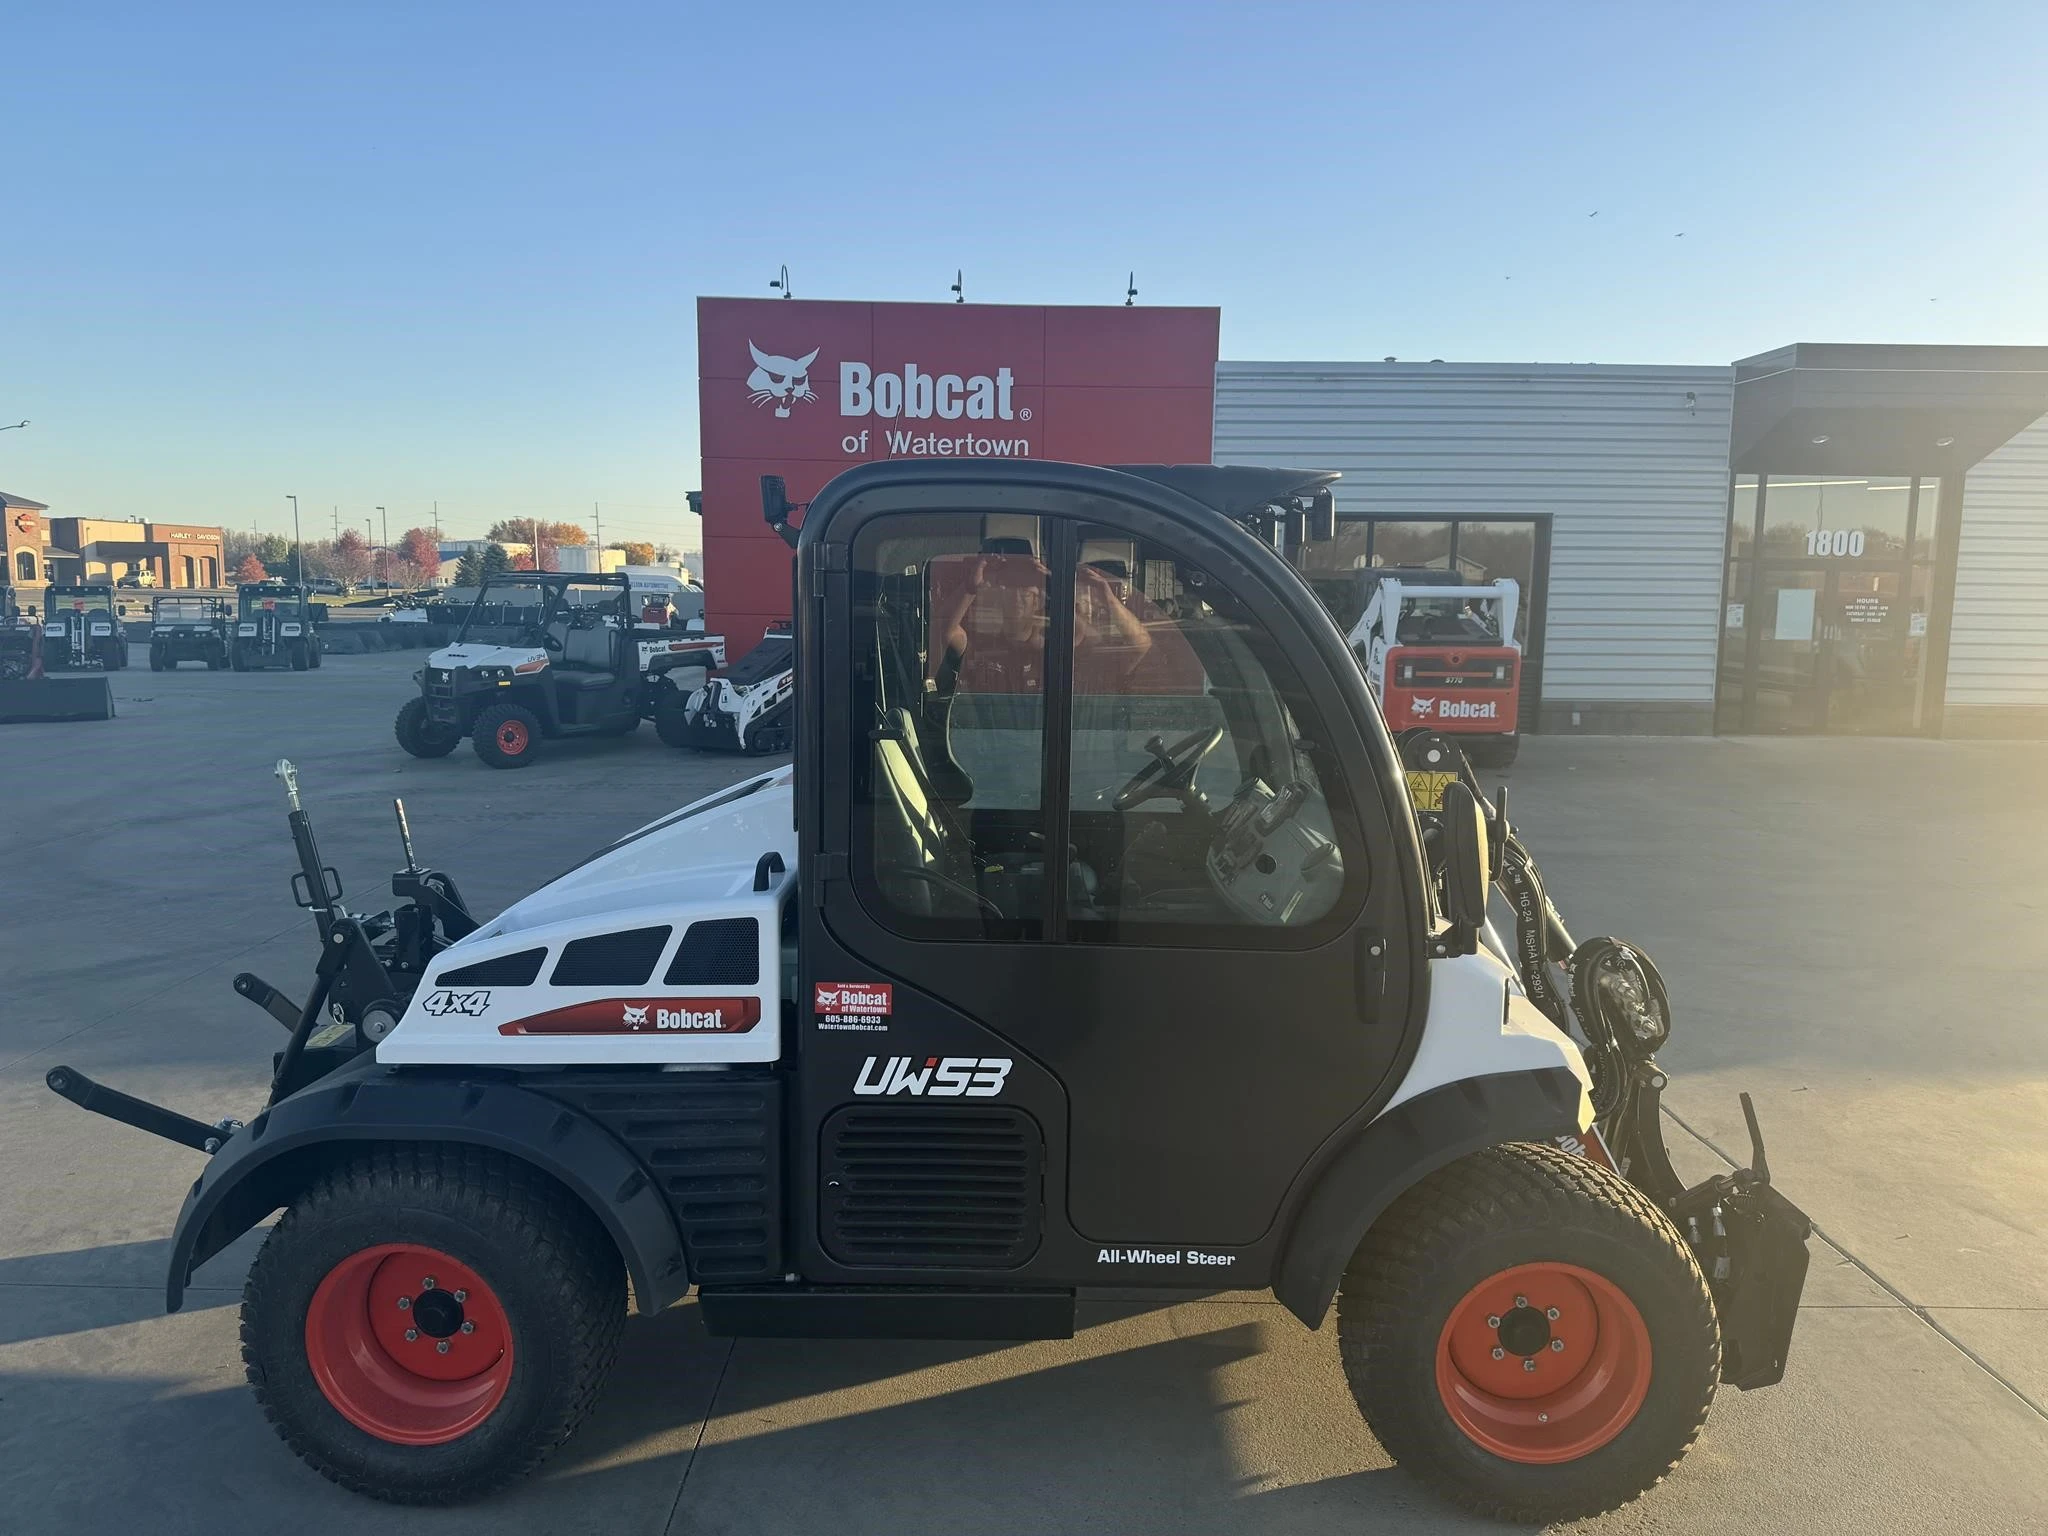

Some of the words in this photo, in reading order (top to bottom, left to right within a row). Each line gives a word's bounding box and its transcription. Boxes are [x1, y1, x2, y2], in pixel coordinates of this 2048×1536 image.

[840, 361, 1014, 421] Bobcat
[841, 430, 869, 453] of
[885, 430, 1029, 456] Watertown
[1807, 530, 1865, 557] 1800
[1439, 700, 1497, 718] Bobcat
[1520, 891, 1533, 922] HG-24
[422, 991, 491, 1016] 4x4
[841, 990, 887, 1005] Bobcat
[656, 1008, 722, 1029] Bobcat
[825, 1014, 881, 1024] 605-886-6933
[849, 1005, 887, 1013] Watertown
[818, 1023, 888, 1031] WatertownBobcat.com
[853, 1056, 1013, 1097] UW53
[1097, 1249, 1181, 1264] All-Wheel
[1187, 1250, 1235, 1265] Steer
